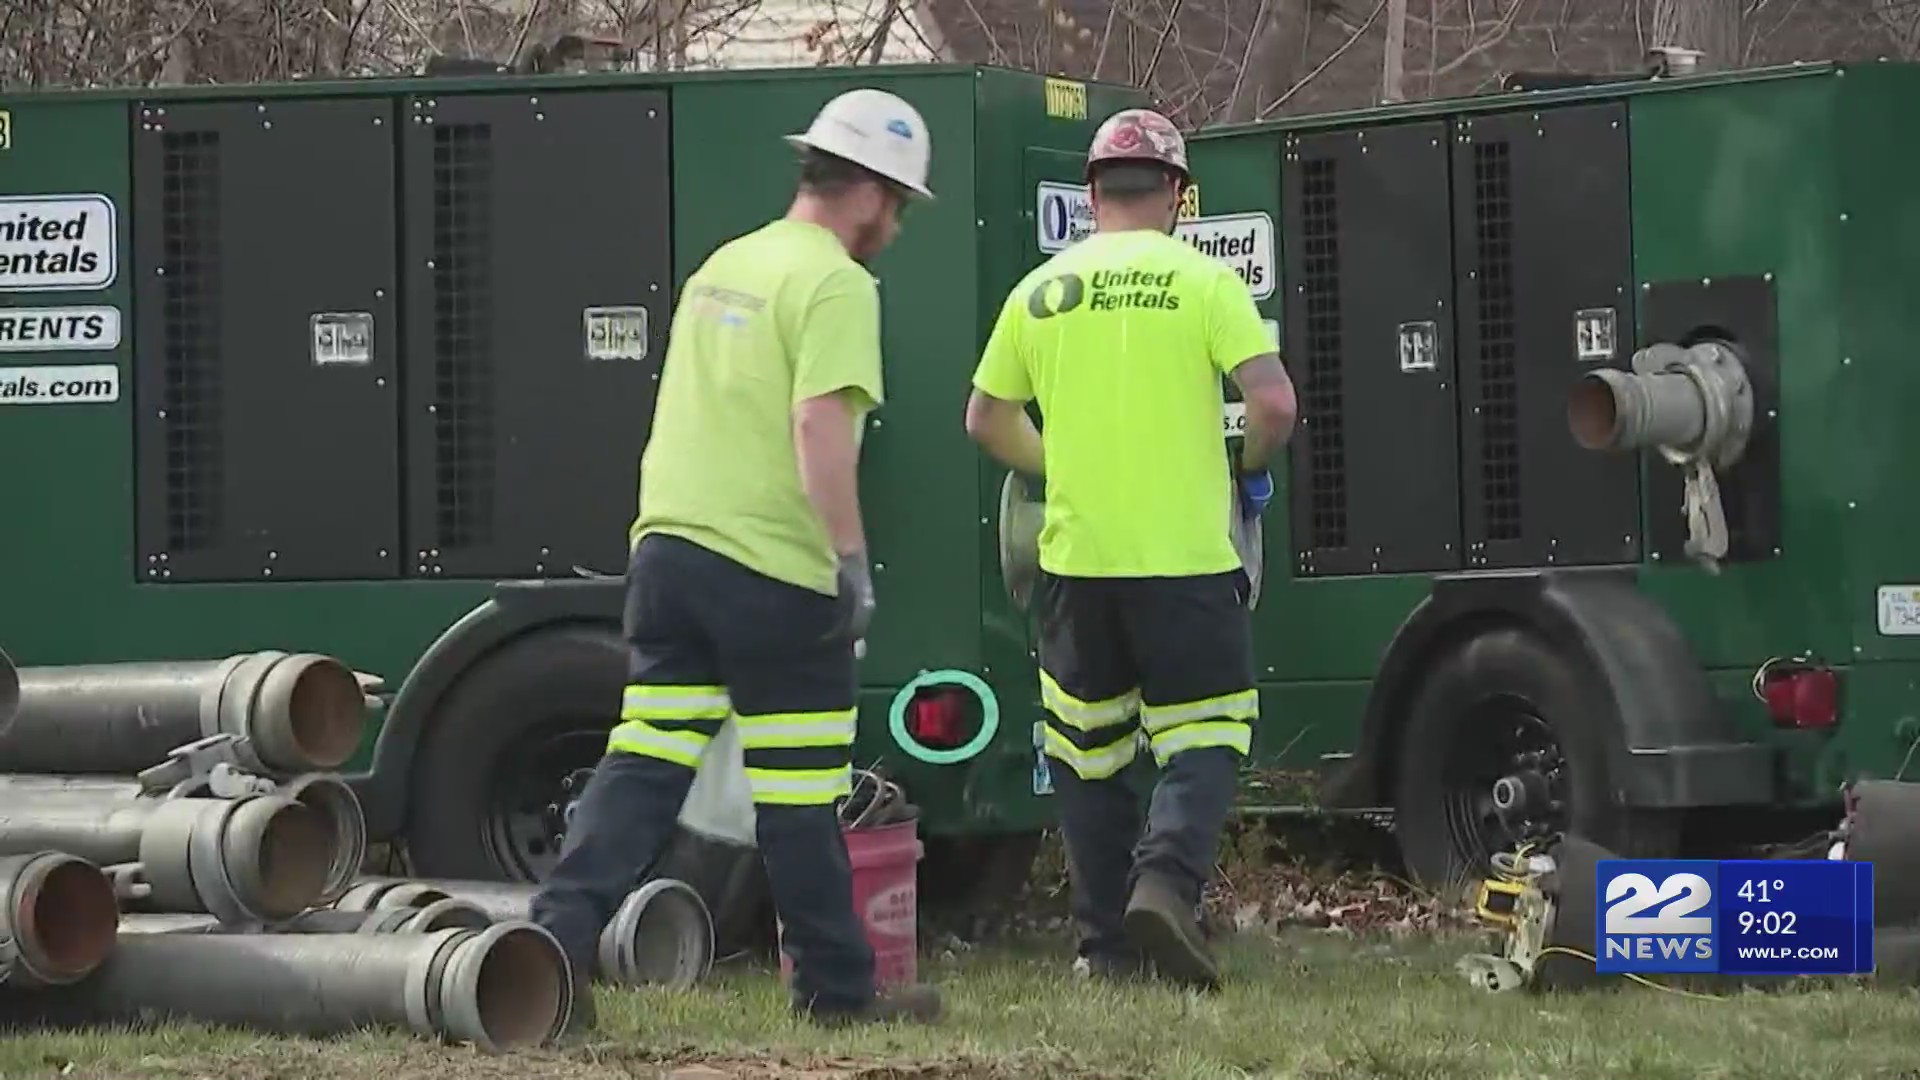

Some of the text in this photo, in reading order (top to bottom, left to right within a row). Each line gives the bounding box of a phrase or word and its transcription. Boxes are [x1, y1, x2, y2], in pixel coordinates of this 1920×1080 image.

[1091, 267, 1176, 290] United
[1090, 290, 1180, 312] Rentals
[0, 315, 104, 341] RENTS
[0, 375, 112, 398] als.com
